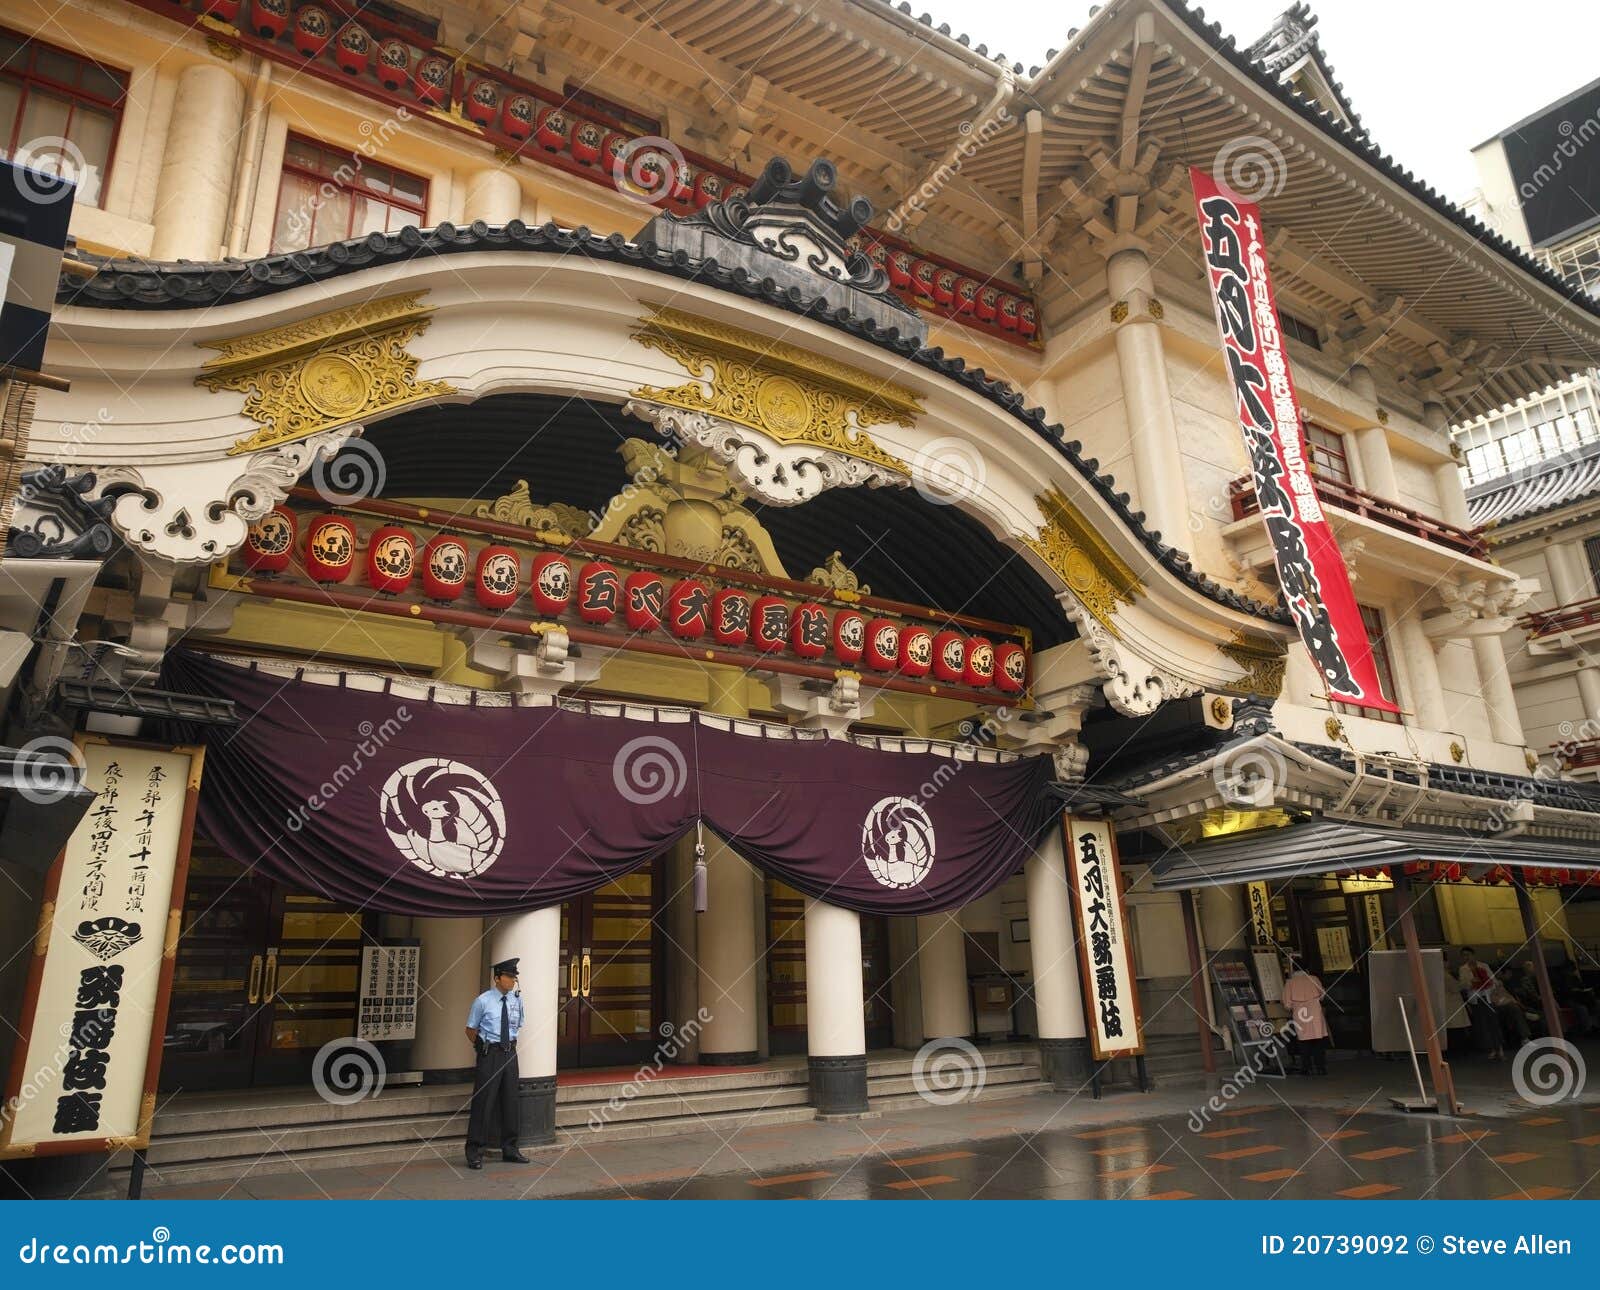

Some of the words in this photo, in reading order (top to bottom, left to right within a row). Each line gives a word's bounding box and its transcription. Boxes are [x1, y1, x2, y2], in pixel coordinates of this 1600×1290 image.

[1078, 832, 1123, 1040] 五月大歌舞伎
[52, 964, 125, 1134] 歌舞伎座
